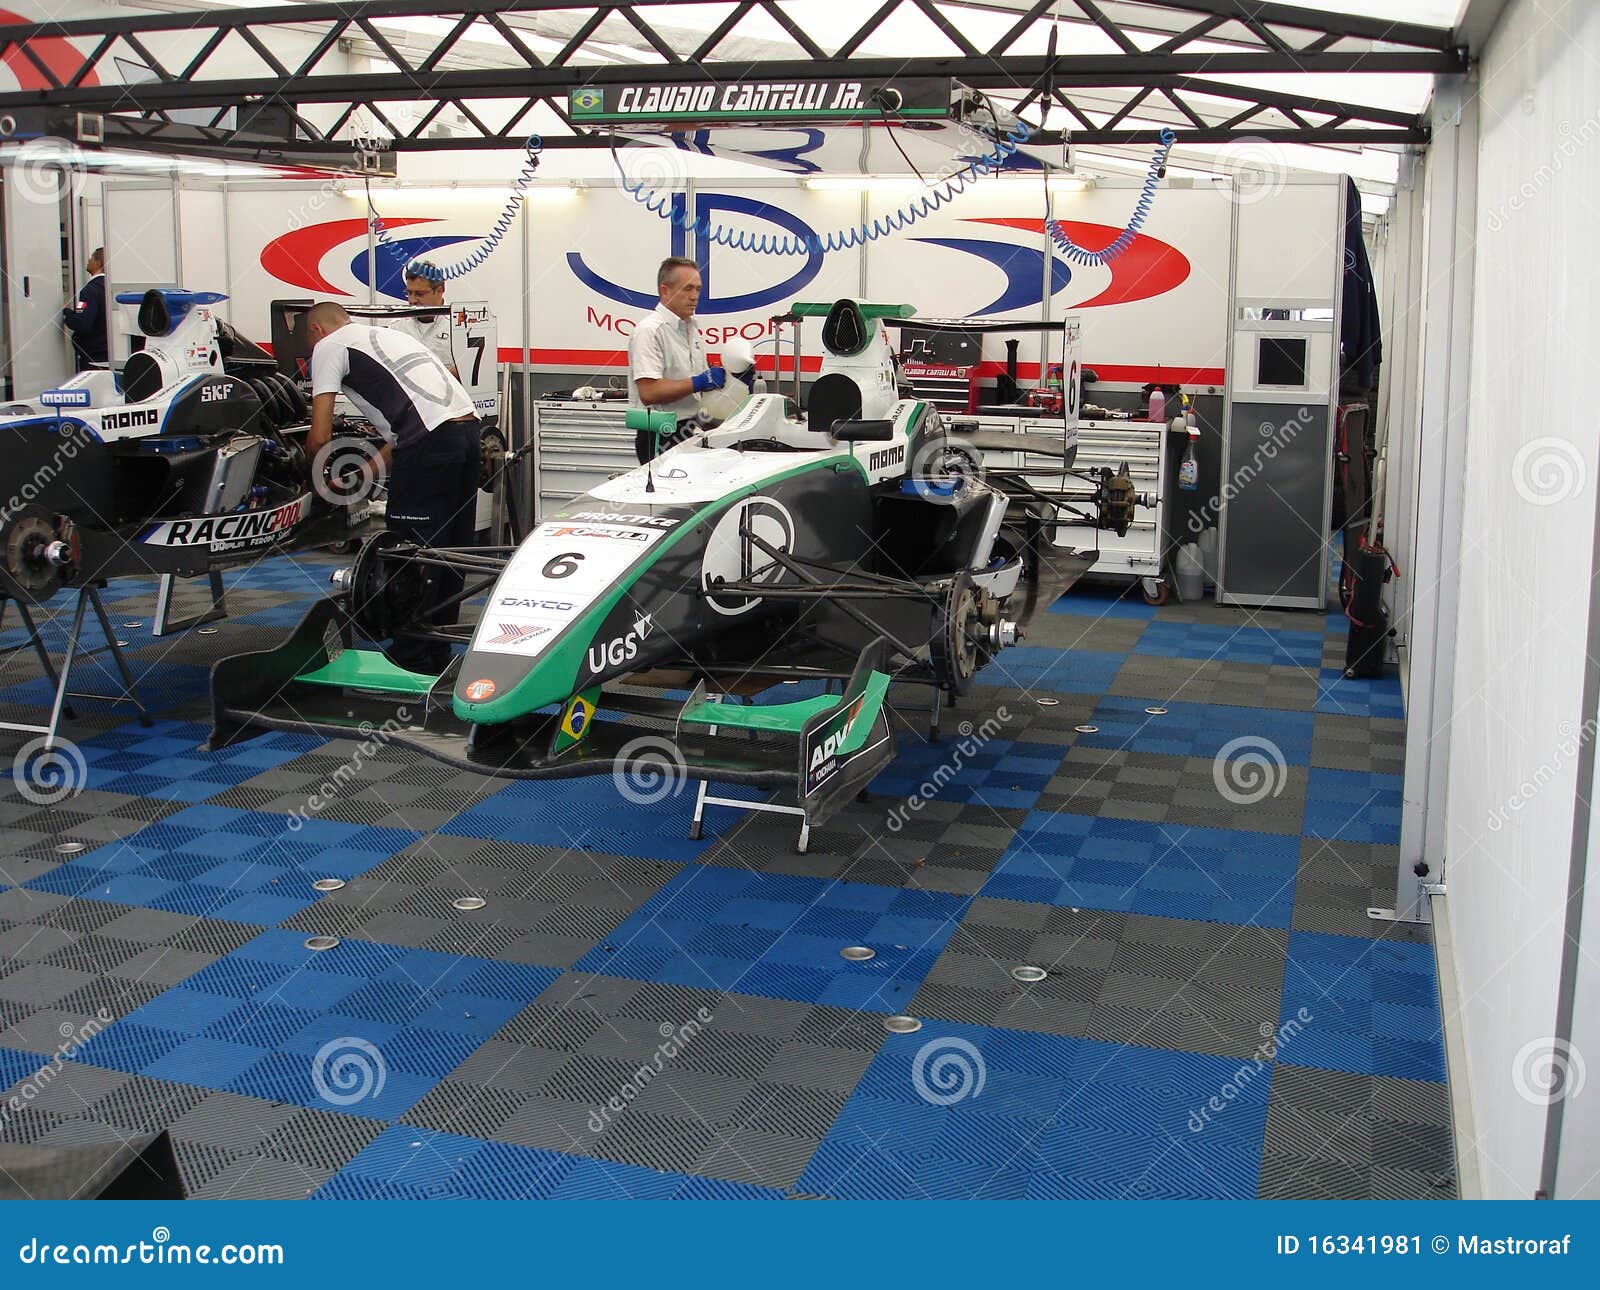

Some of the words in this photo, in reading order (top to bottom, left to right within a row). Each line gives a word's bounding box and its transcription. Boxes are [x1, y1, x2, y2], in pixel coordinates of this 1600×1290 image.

[617, 86, 716, 112] CLAUDIO
[719, 84, 828, 111] CANTELLI
[830, 83, 864, 109] JR.
[467, 337, 485, 386] 7
[201, 384, 233, 402] SKF
[1069, 360, 1077, 414] 6
[570, 512, 680, 527] PRACTICE
[542, 552, 585, 579] 6
[501, 597, 574, 611] DAYCO
[588, 632, 637, 674] UGS
